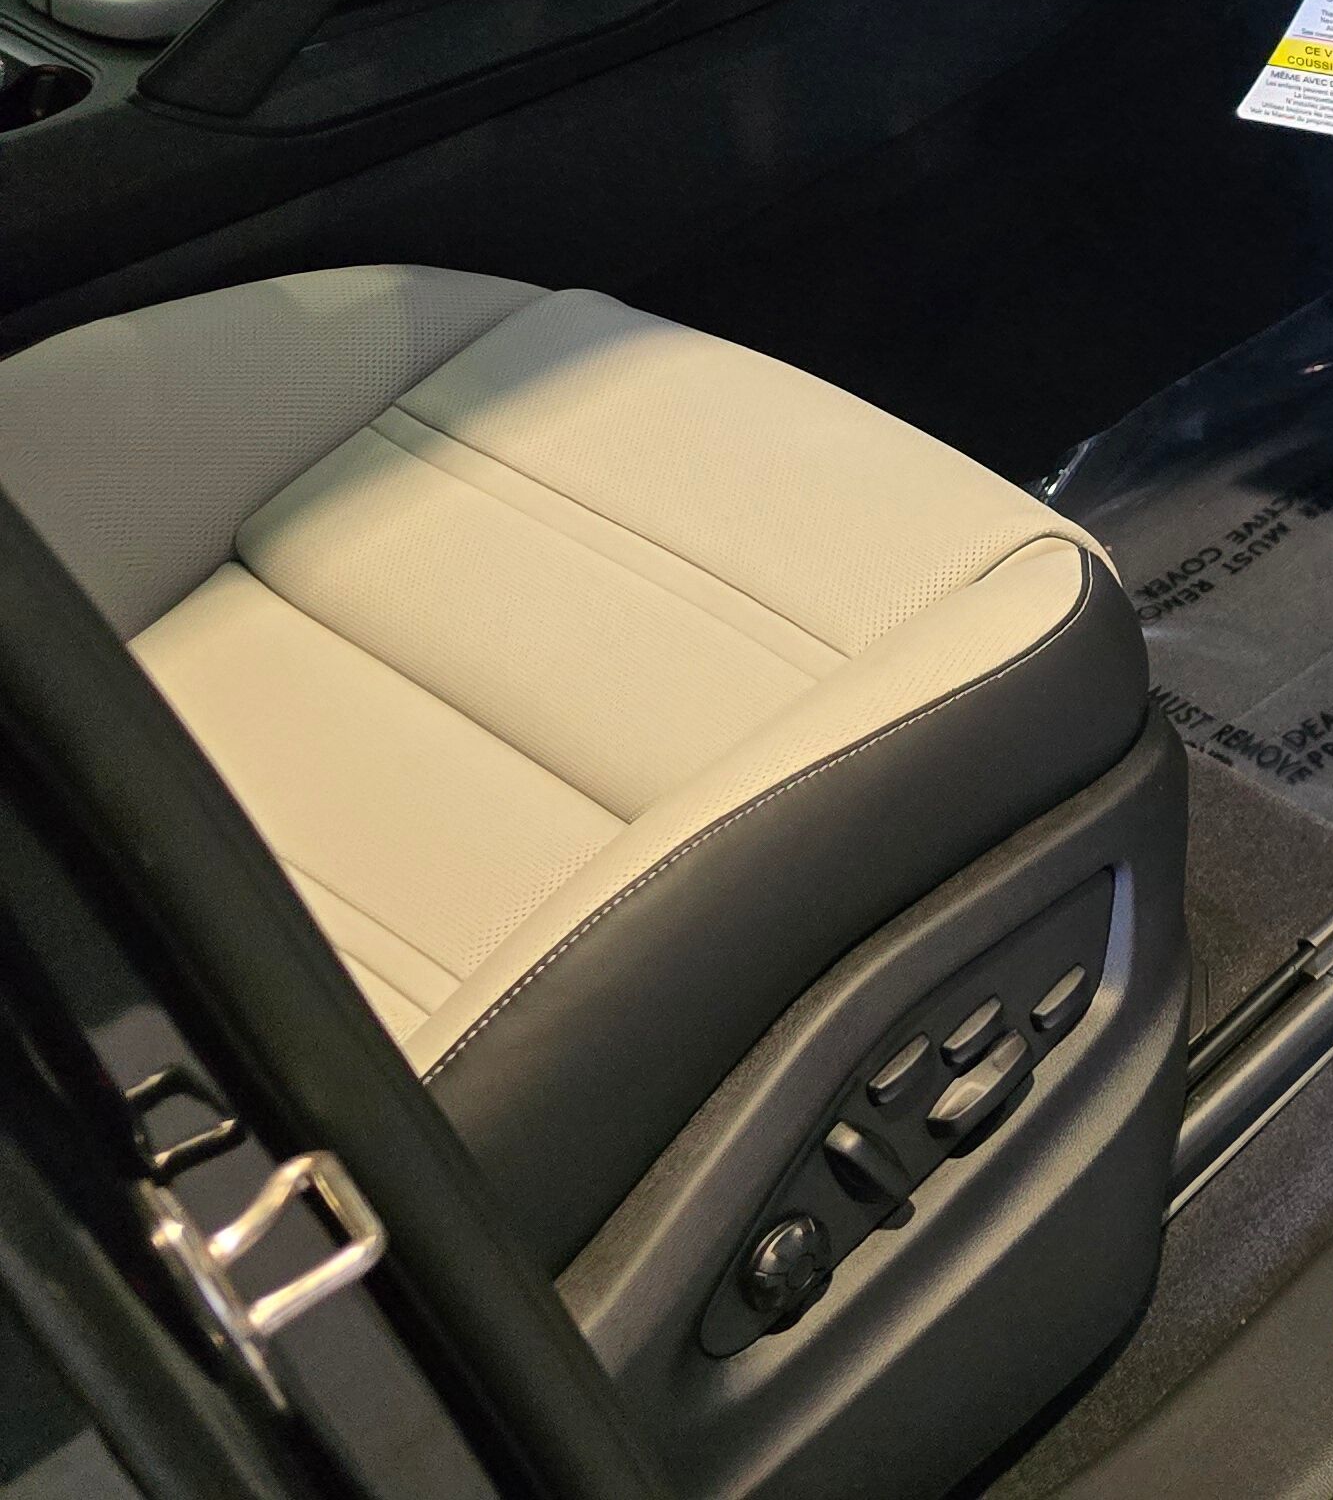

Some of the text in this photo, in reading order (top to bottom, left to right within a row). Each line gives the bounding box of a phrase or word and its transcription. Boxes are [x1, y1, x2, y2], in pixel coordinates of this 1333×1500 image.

[1270, 70, 1300, 82] MÊME
[1303, 76, 1327, 86] AVEC
[1305, 45, 1321, 57] CE
[1134, 546, 1224, 600] COVER
[1222, 521, 1291, 576] MUST
[1147, 684, 1218, 730] MUST
[1209, 723, 1313, 786] REMOVE
